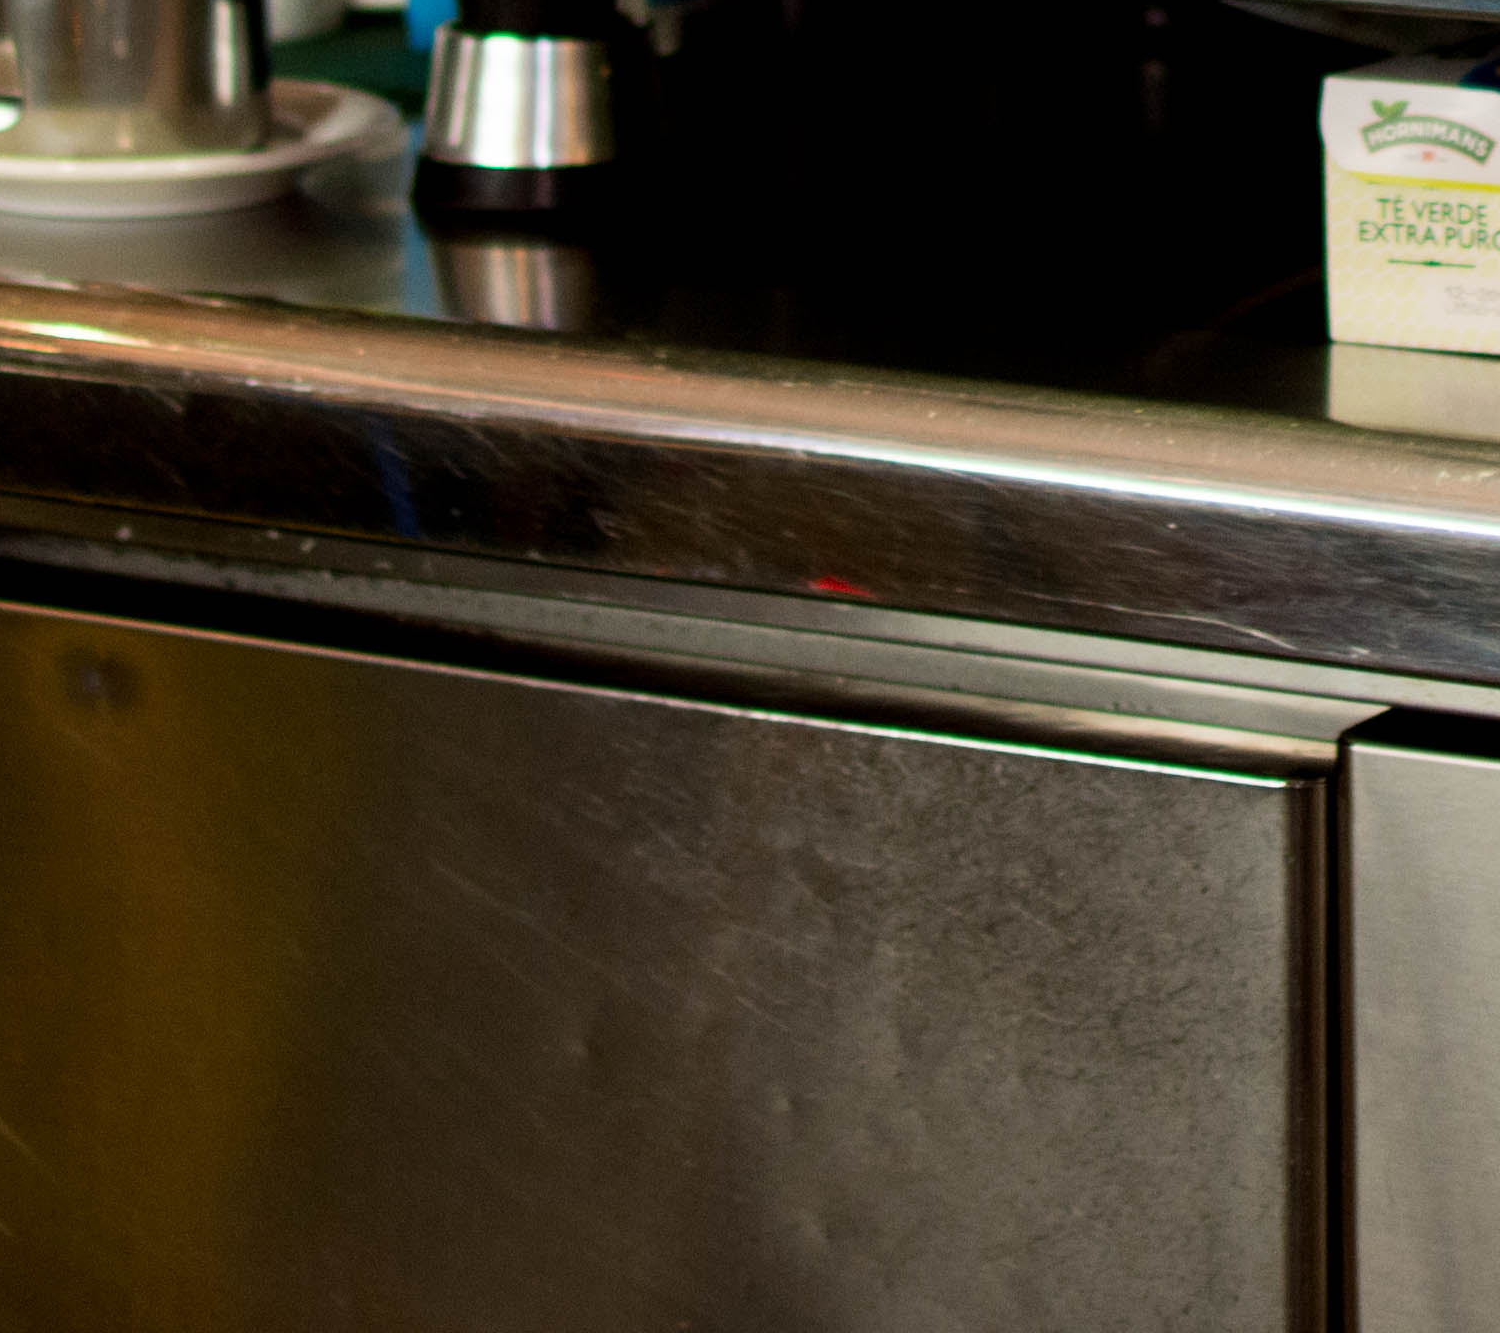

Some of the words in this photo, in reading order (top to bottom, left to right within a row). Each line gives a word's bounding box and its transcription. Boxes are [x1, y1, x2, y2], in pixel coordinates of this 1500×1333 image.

[1366, 117, 1489, 160] HORNIMANS
[1411, 201, 1488, 227] VERDE
[1358, 221, 1436, 245] EXTRA
